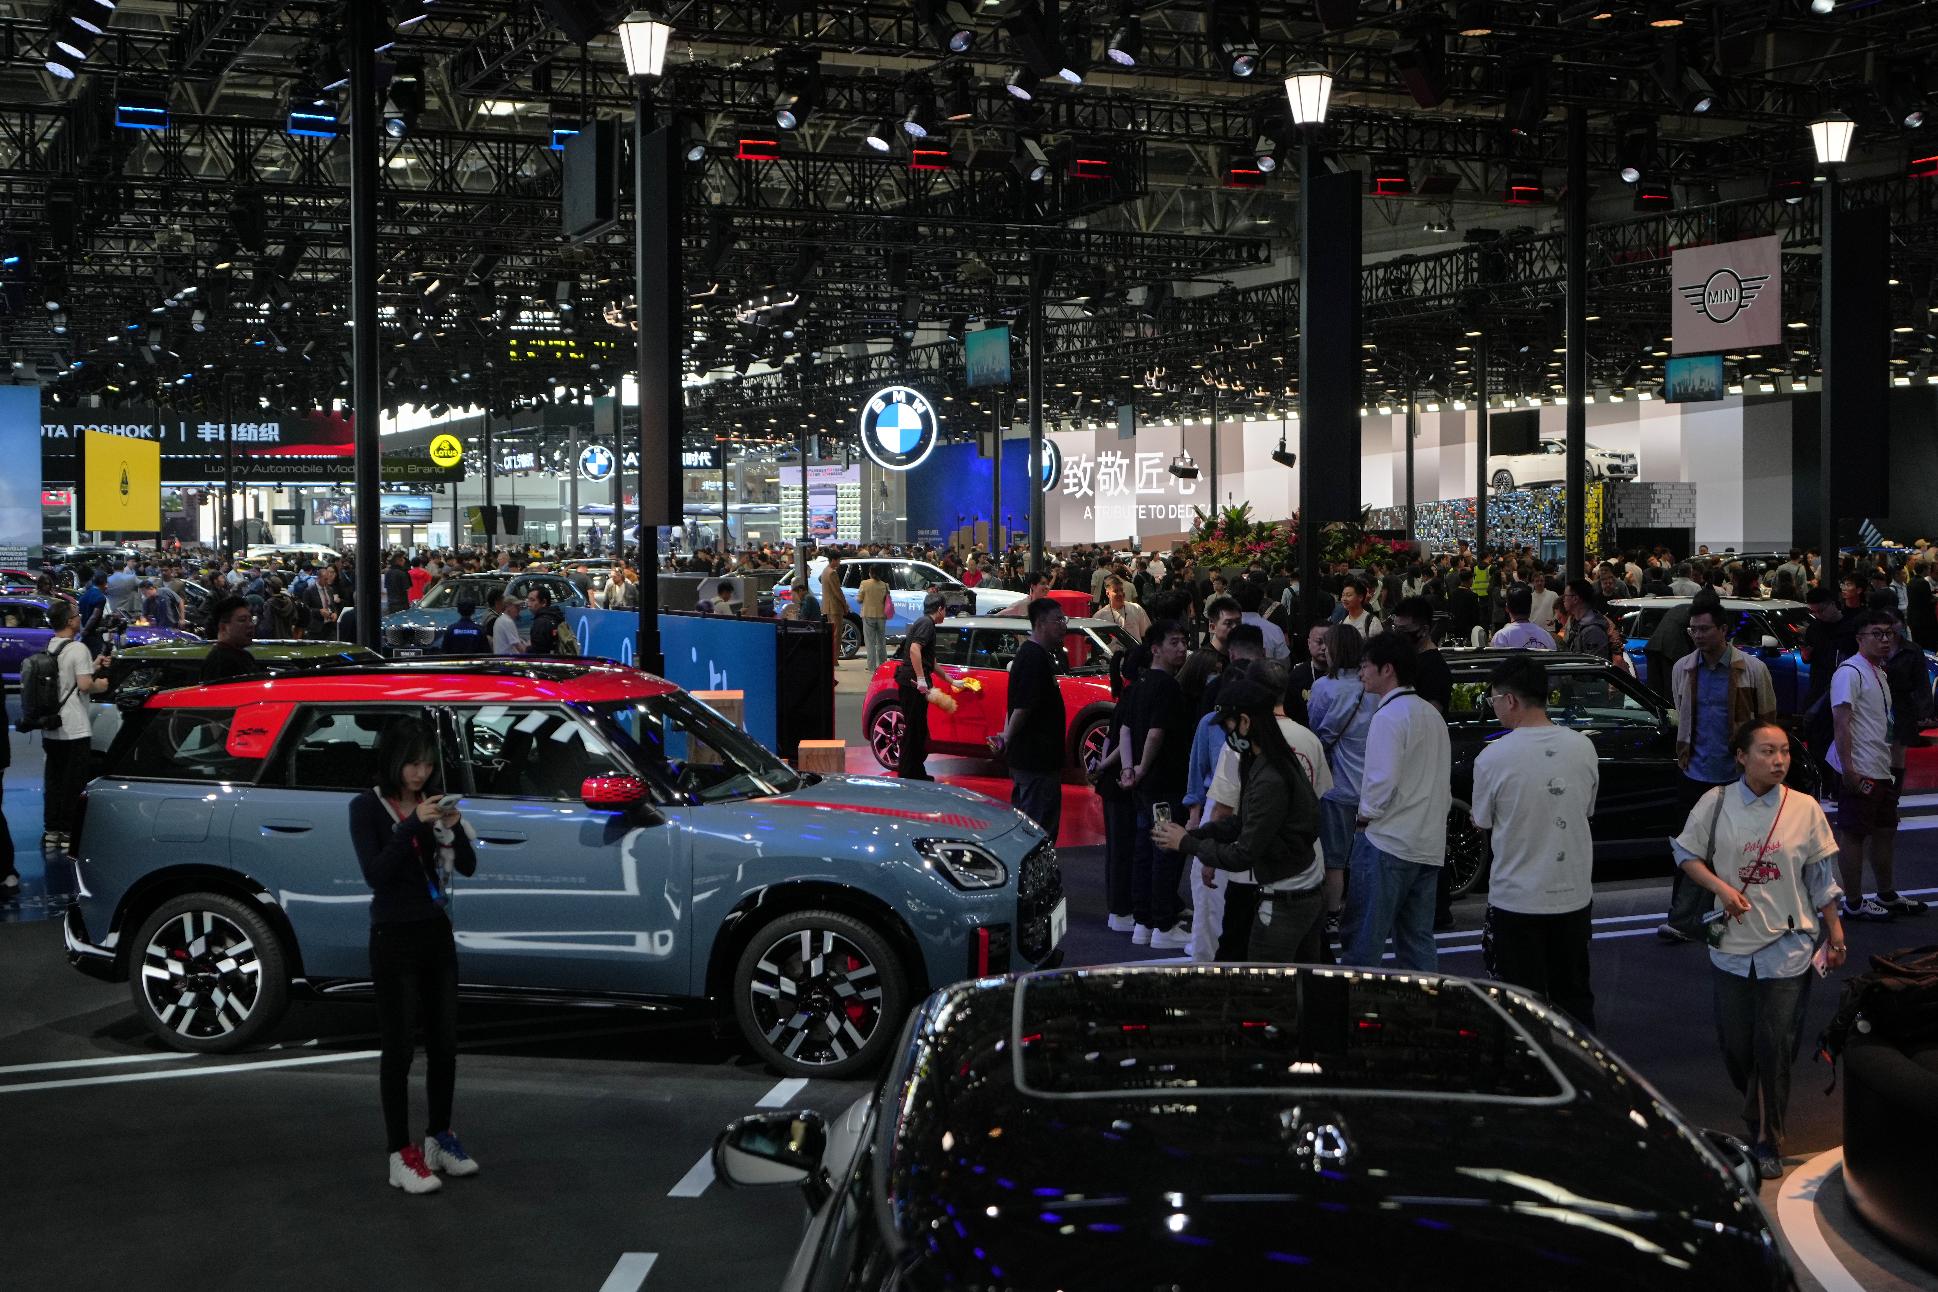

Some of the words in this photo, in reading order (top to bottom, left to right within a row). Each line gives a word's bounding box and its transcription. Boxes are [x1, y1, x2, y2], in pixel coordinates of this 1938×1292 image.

[1709, 287, 1739, 305] MINI
[196, 421, 281, 442] 丰田纺织
[434, 449, 458, 457] LOTUS
[204, 463, 250, 475] Luxry
[251, 463, 324, 474] Automobile
[327, 464, 404, 474] Modtion
[407, 464, 446, 474] Brand
[1062, 449, 1205, 499] 致敬匠心
[1083, 505, 1093, 520] A
[1148, 503, 1166, 519] TO
